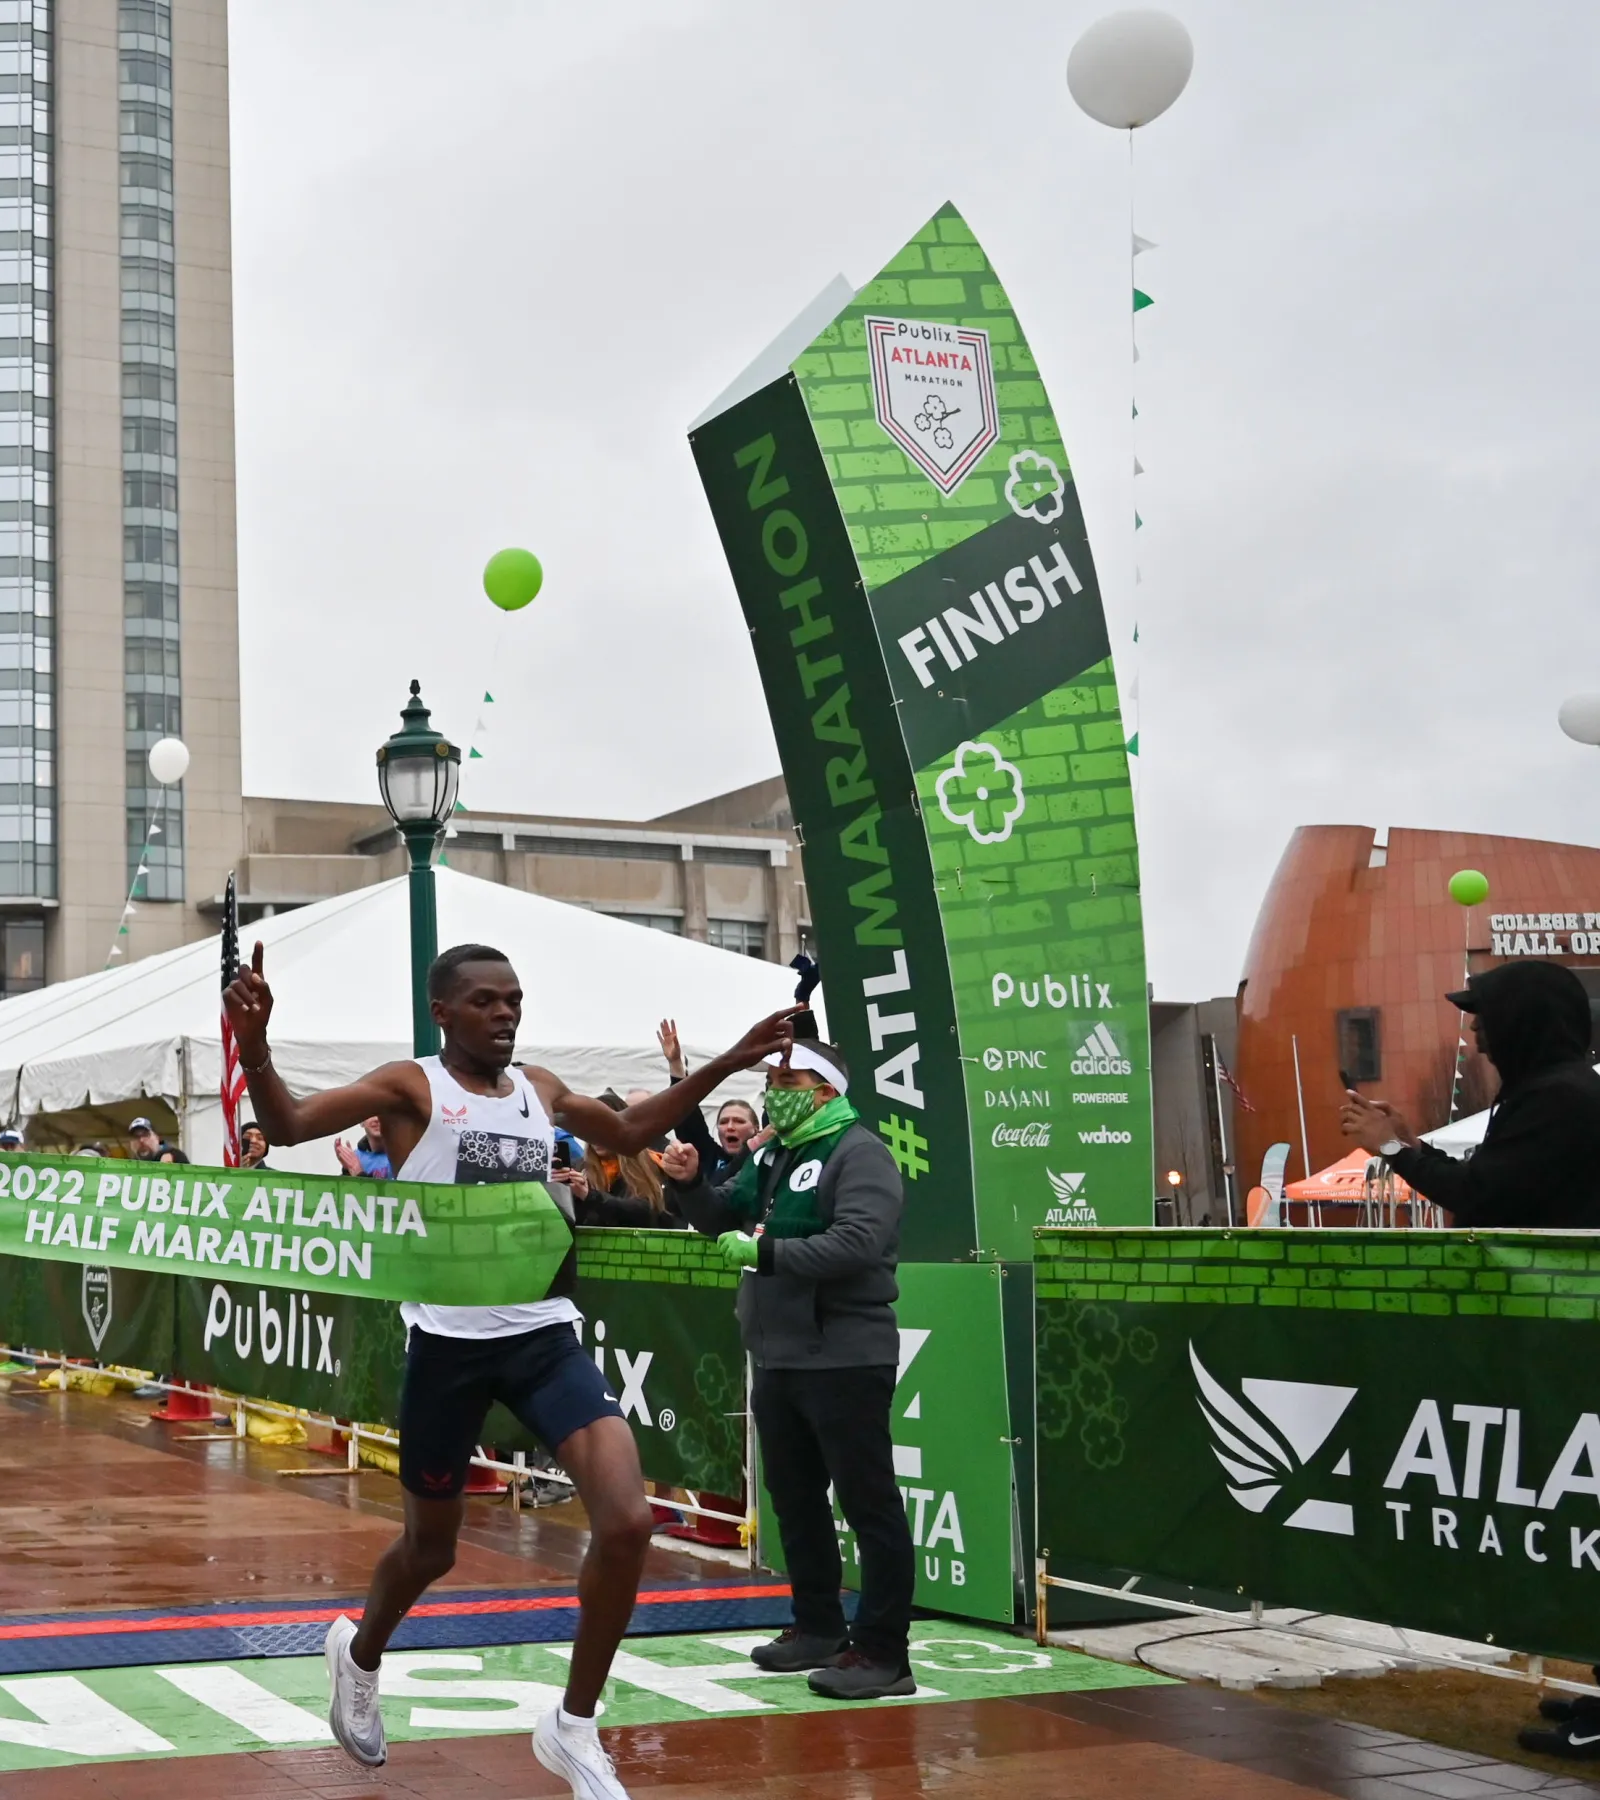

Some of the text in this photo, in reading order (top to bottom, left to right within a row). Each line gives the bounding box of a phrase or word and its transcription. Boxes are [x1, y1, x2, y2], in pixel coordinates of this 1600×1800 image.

[891, 347, 972, 371] ATLANTA
[905, 373, 963, 387] MARATHON
[897, 542, 1083, 689] FINISH
[1491, 913, 1579, 931] COLLEGE
[1492, 932, 1563, 955] HALL
[1004, 1050, 1048, 1068] PNC
[1071, 1056, 1132, 1075] adidas
[985, 1085, 1050, 1111] DASANI
[1072, 1093, 1129, 1103] POWERADE
[1078, 1125, 1132, 1144] wahoo
[96, 1173, 232, 1219] PUBLIX
[242, 1187, 428, 1238] ATLANTA
[1045, 1207, 1097, 1222] ATLANTA
[25, 1209, 373, 1280] HALF MARATHON
[1382, 1398, 1600, 1510] ATLA
[1385, 1501, 1600, 1571] TRACK
